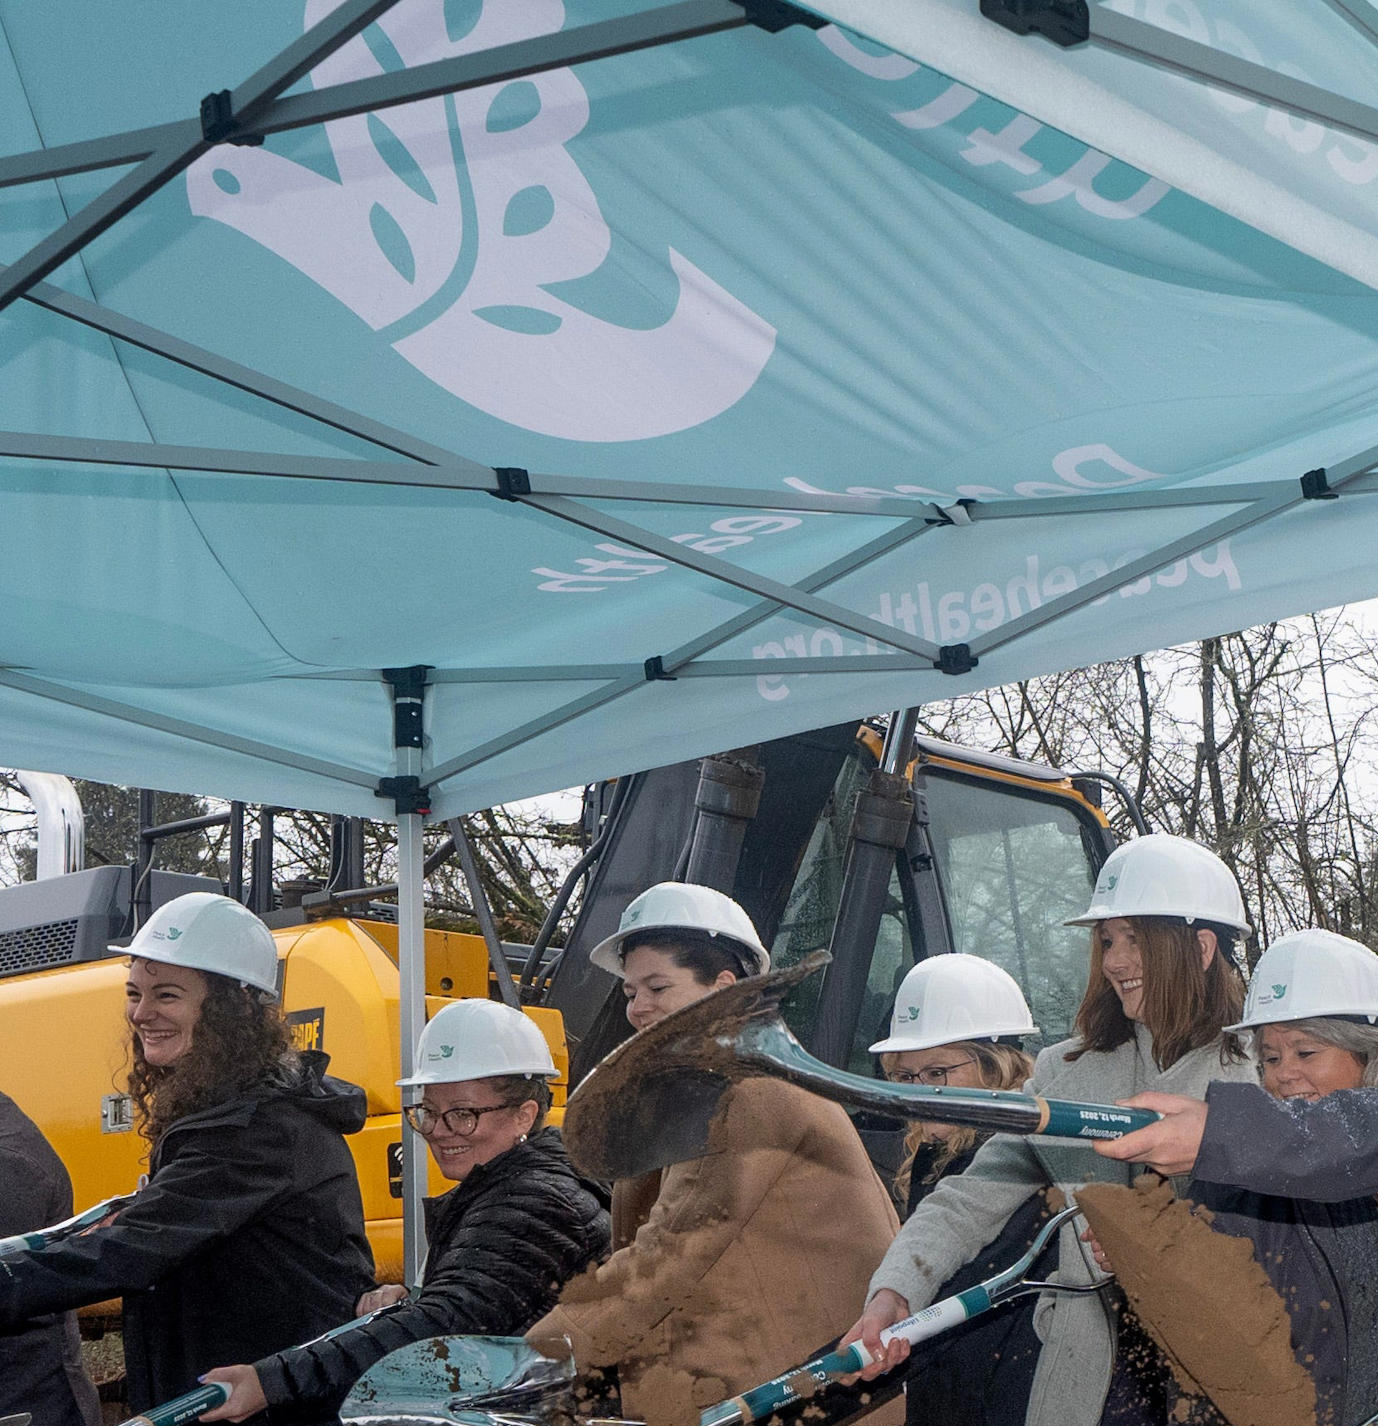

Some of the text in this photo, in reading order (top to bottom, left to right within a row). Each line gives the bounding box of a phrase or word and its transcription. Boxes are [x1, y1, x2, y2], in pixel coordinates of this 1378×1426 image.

[1080, 1110, 1099, 1120] 2025
[1110, 1113, 1132, 1124] March
[1079, 1125, 1124, 1140] Ceremony
[889, 1316, 921, 1334] Lifepoint
